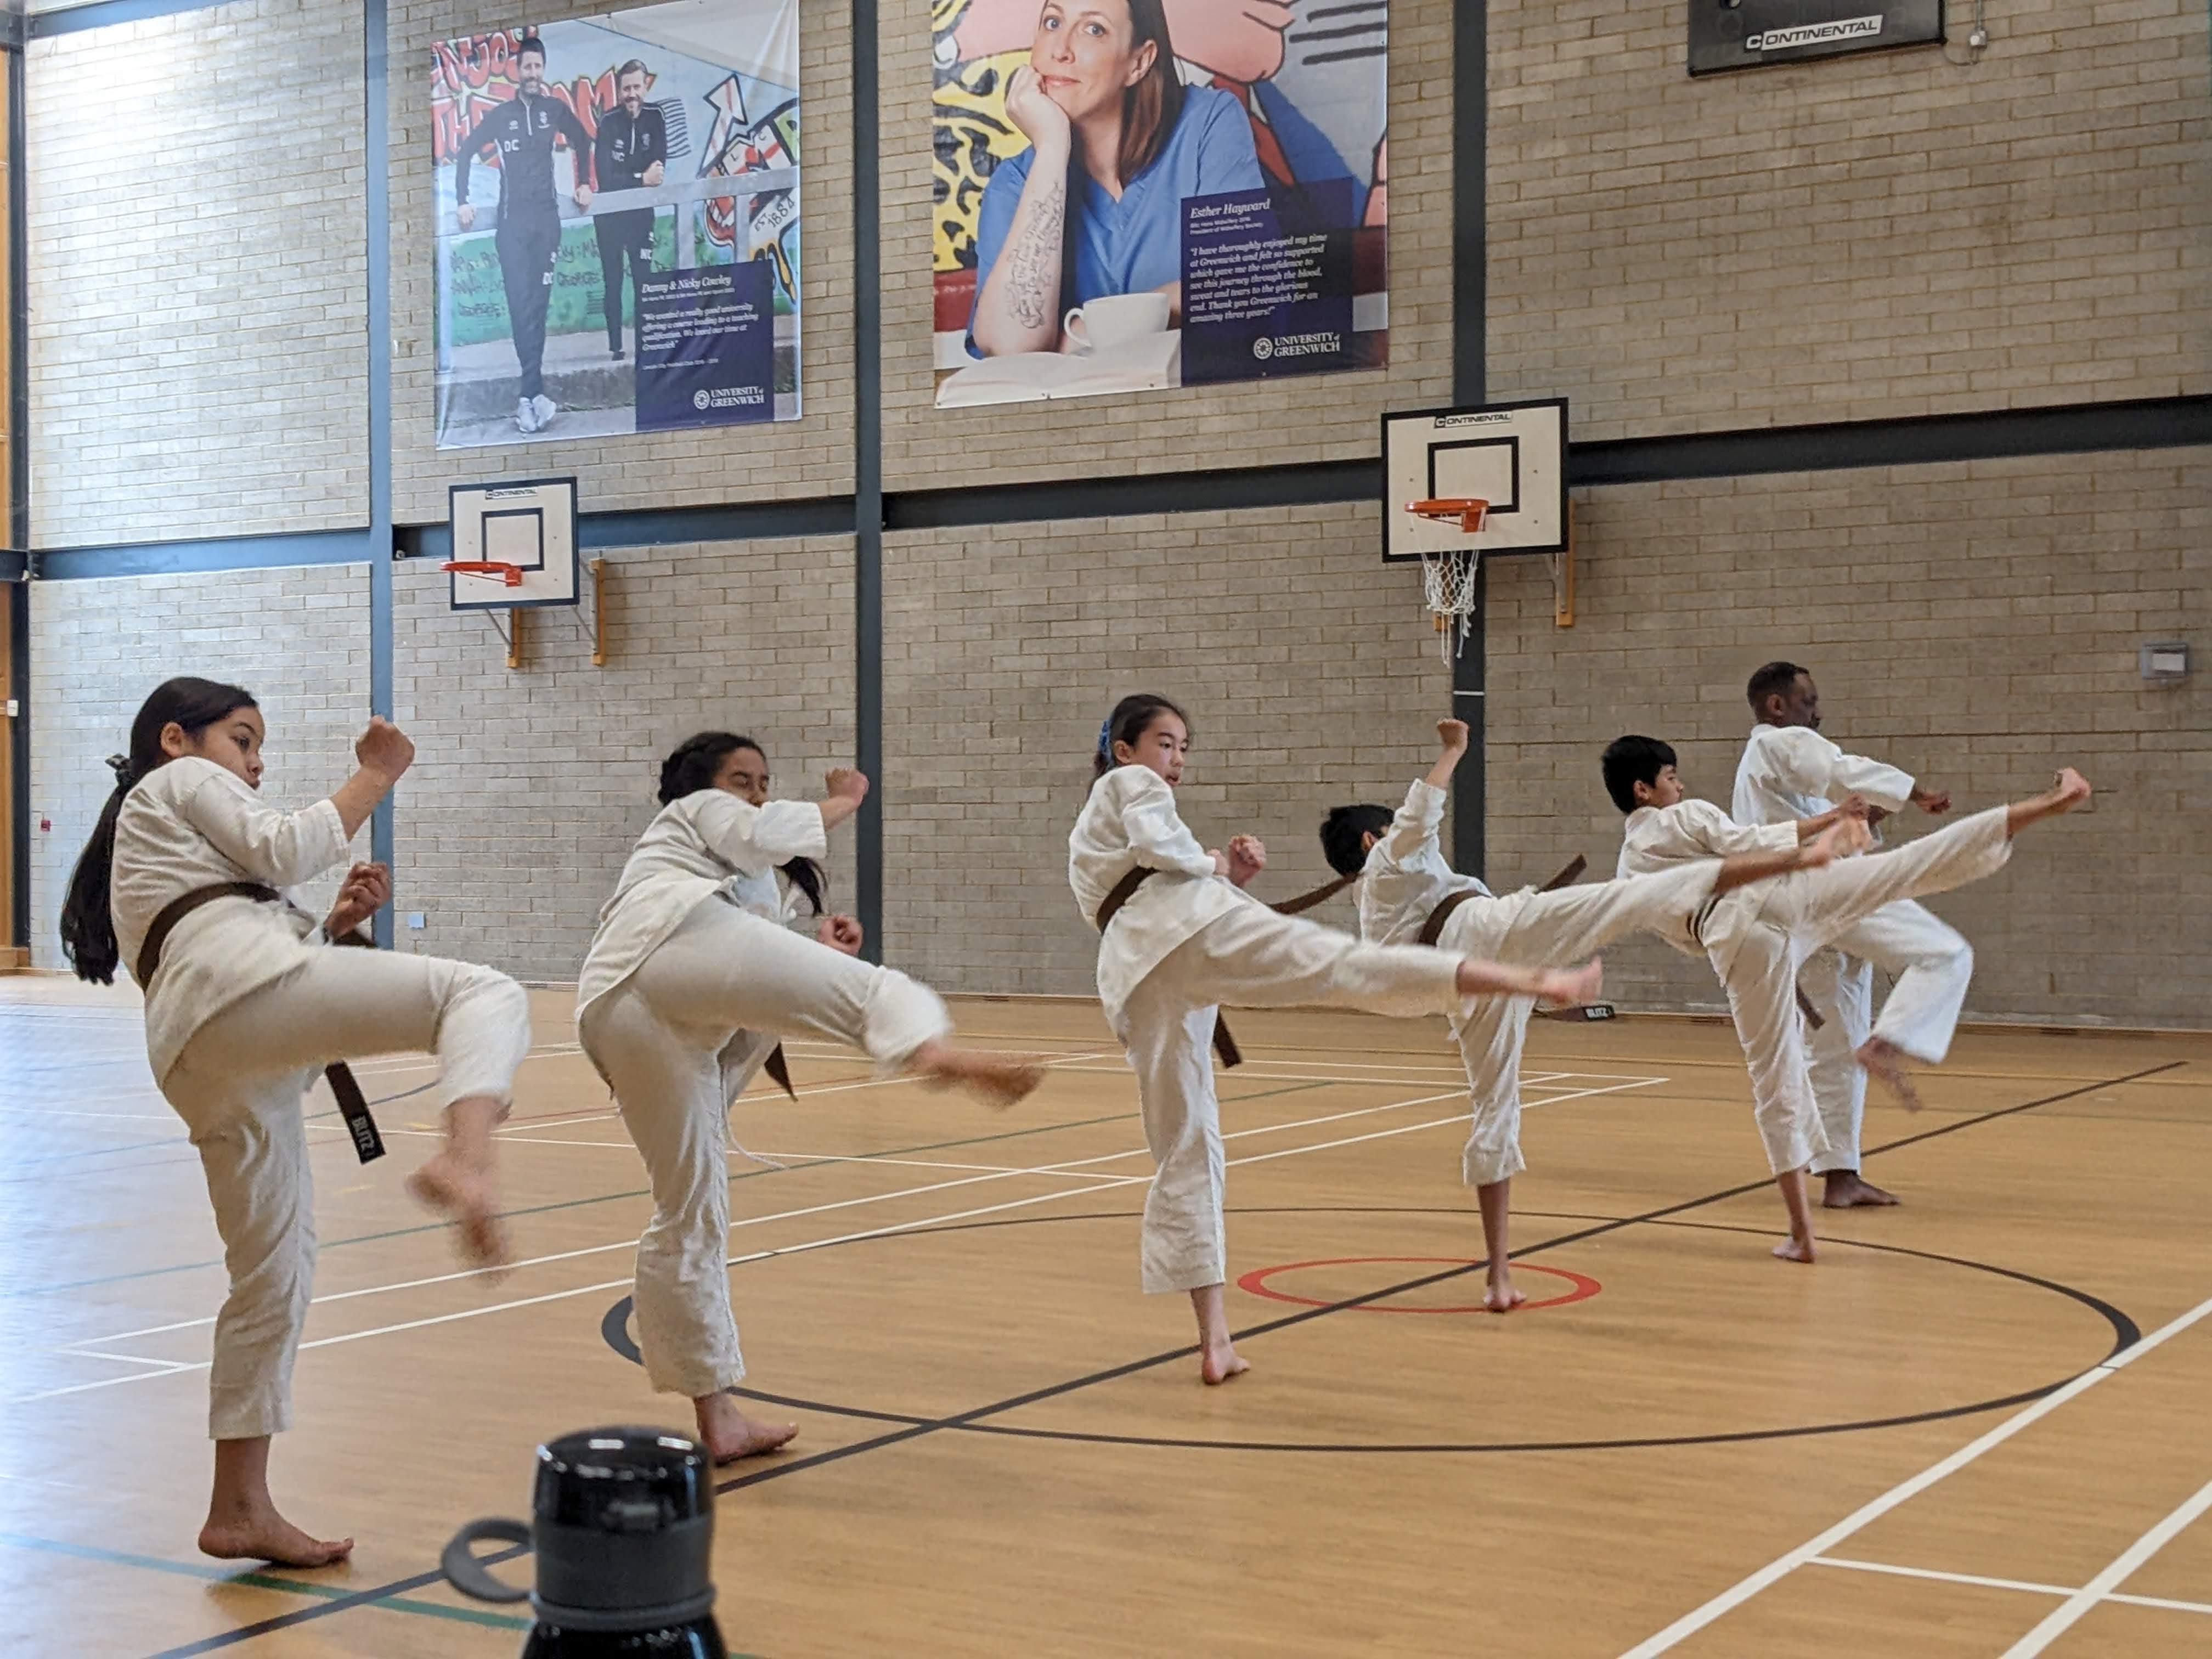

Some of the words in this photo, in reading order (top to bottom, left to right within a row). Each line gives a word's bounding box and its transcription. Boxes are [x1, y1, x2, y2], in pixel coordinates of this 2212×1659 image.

[1746, 20, 1877, 49] CONTINENTAL
[504, 139, 520, 152] DC
[1190, 206, 1222, 218] Esther
[1223, 198, 1271, 215] Hayward
[1199, 246, 1217, 255] have
[1218, 240, 1261, 253] thoroughly
[1262, 236, 1294, 249] enjoyed
[1295, 237, 1307, 245] my
[1309, 234, 1327, 242] time
[1200, 253, 1240, 266] Greenwich
[1242, 252, 1258, 261] and
[1284, 244, 1324, 258] supported
[1190, 268, 1213, 279] which
[1214, 268, 1233, 278] gave
[1248, 263, 1260, 272] the
[1261, 259, 1304, 271] confidence
[669, 281, 677, 290] &
[1204, 279, 1218, 288] this
[1218, 278, 1249, 289] journey
[1251, 272, 1282, 283] through
[1284, 270, 1296, 279] the
[1190, 292, 1212, 301] sweat
[1214, 288, 1230, 298] and
[1262, 284, 1274, 293] the
[1275, 281, 1308, 294] glorious
[1208, 300, 1232, 310] Thank
[1234, 301, 1249, 309] you
[1250, 292, 1291, 305] Greenwich
[1291, 292, 1306, 303] for
[1224, 311, 1245, 319] three
[1274, 332, 1334, 346] UNIVERSITY
[1274, 341, 1340, 357] GREENWICH
[711, 386, 759, 398] UNIVERSITY
[711, 394, 764, 407] GREENWICH
[1436, 414, 1510, 426] CONTINENTAL
